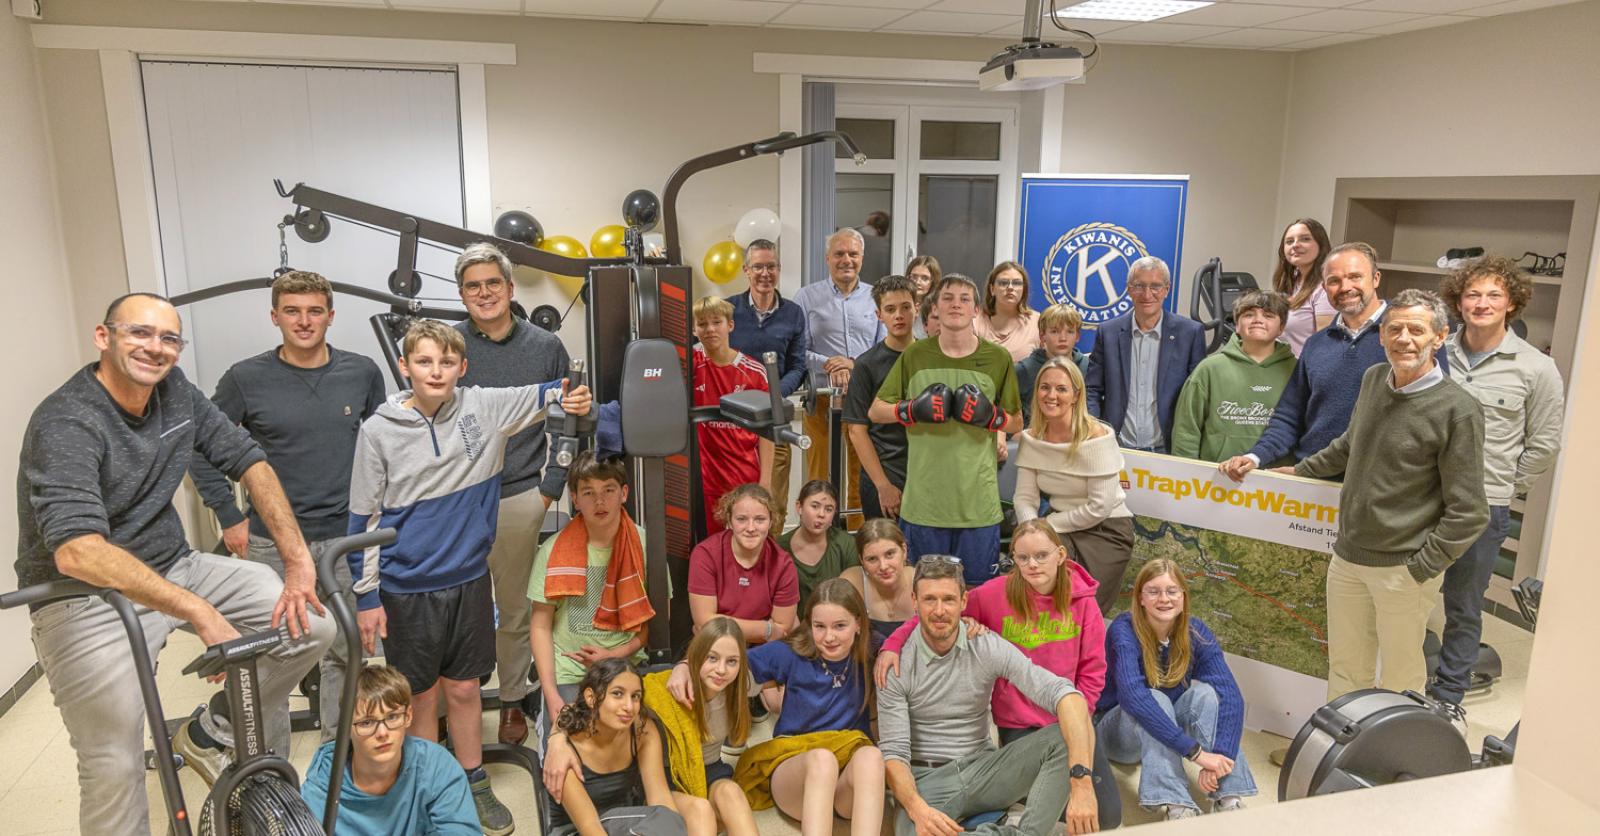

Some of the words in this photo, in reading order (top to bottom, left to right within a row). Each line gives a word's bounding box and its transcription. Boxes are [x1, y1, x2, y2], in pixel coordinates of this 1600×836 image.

[1063, 231, 1136, 257] KIWANIS
[1072, 246, 1123, 308] K
[1051, 266, 1133, 321] INTERNATIO
[643, 368, 663, 378] BH
[931, 394, 945, 422] UFC
[961, 394, 978, 422] UFC
[1288, 521, 1324, 535] Afstand
[227, 635, 280, 655] ASSAULTFITNESS
[239, 667, 258, 756] ASSAULTFITNESS
